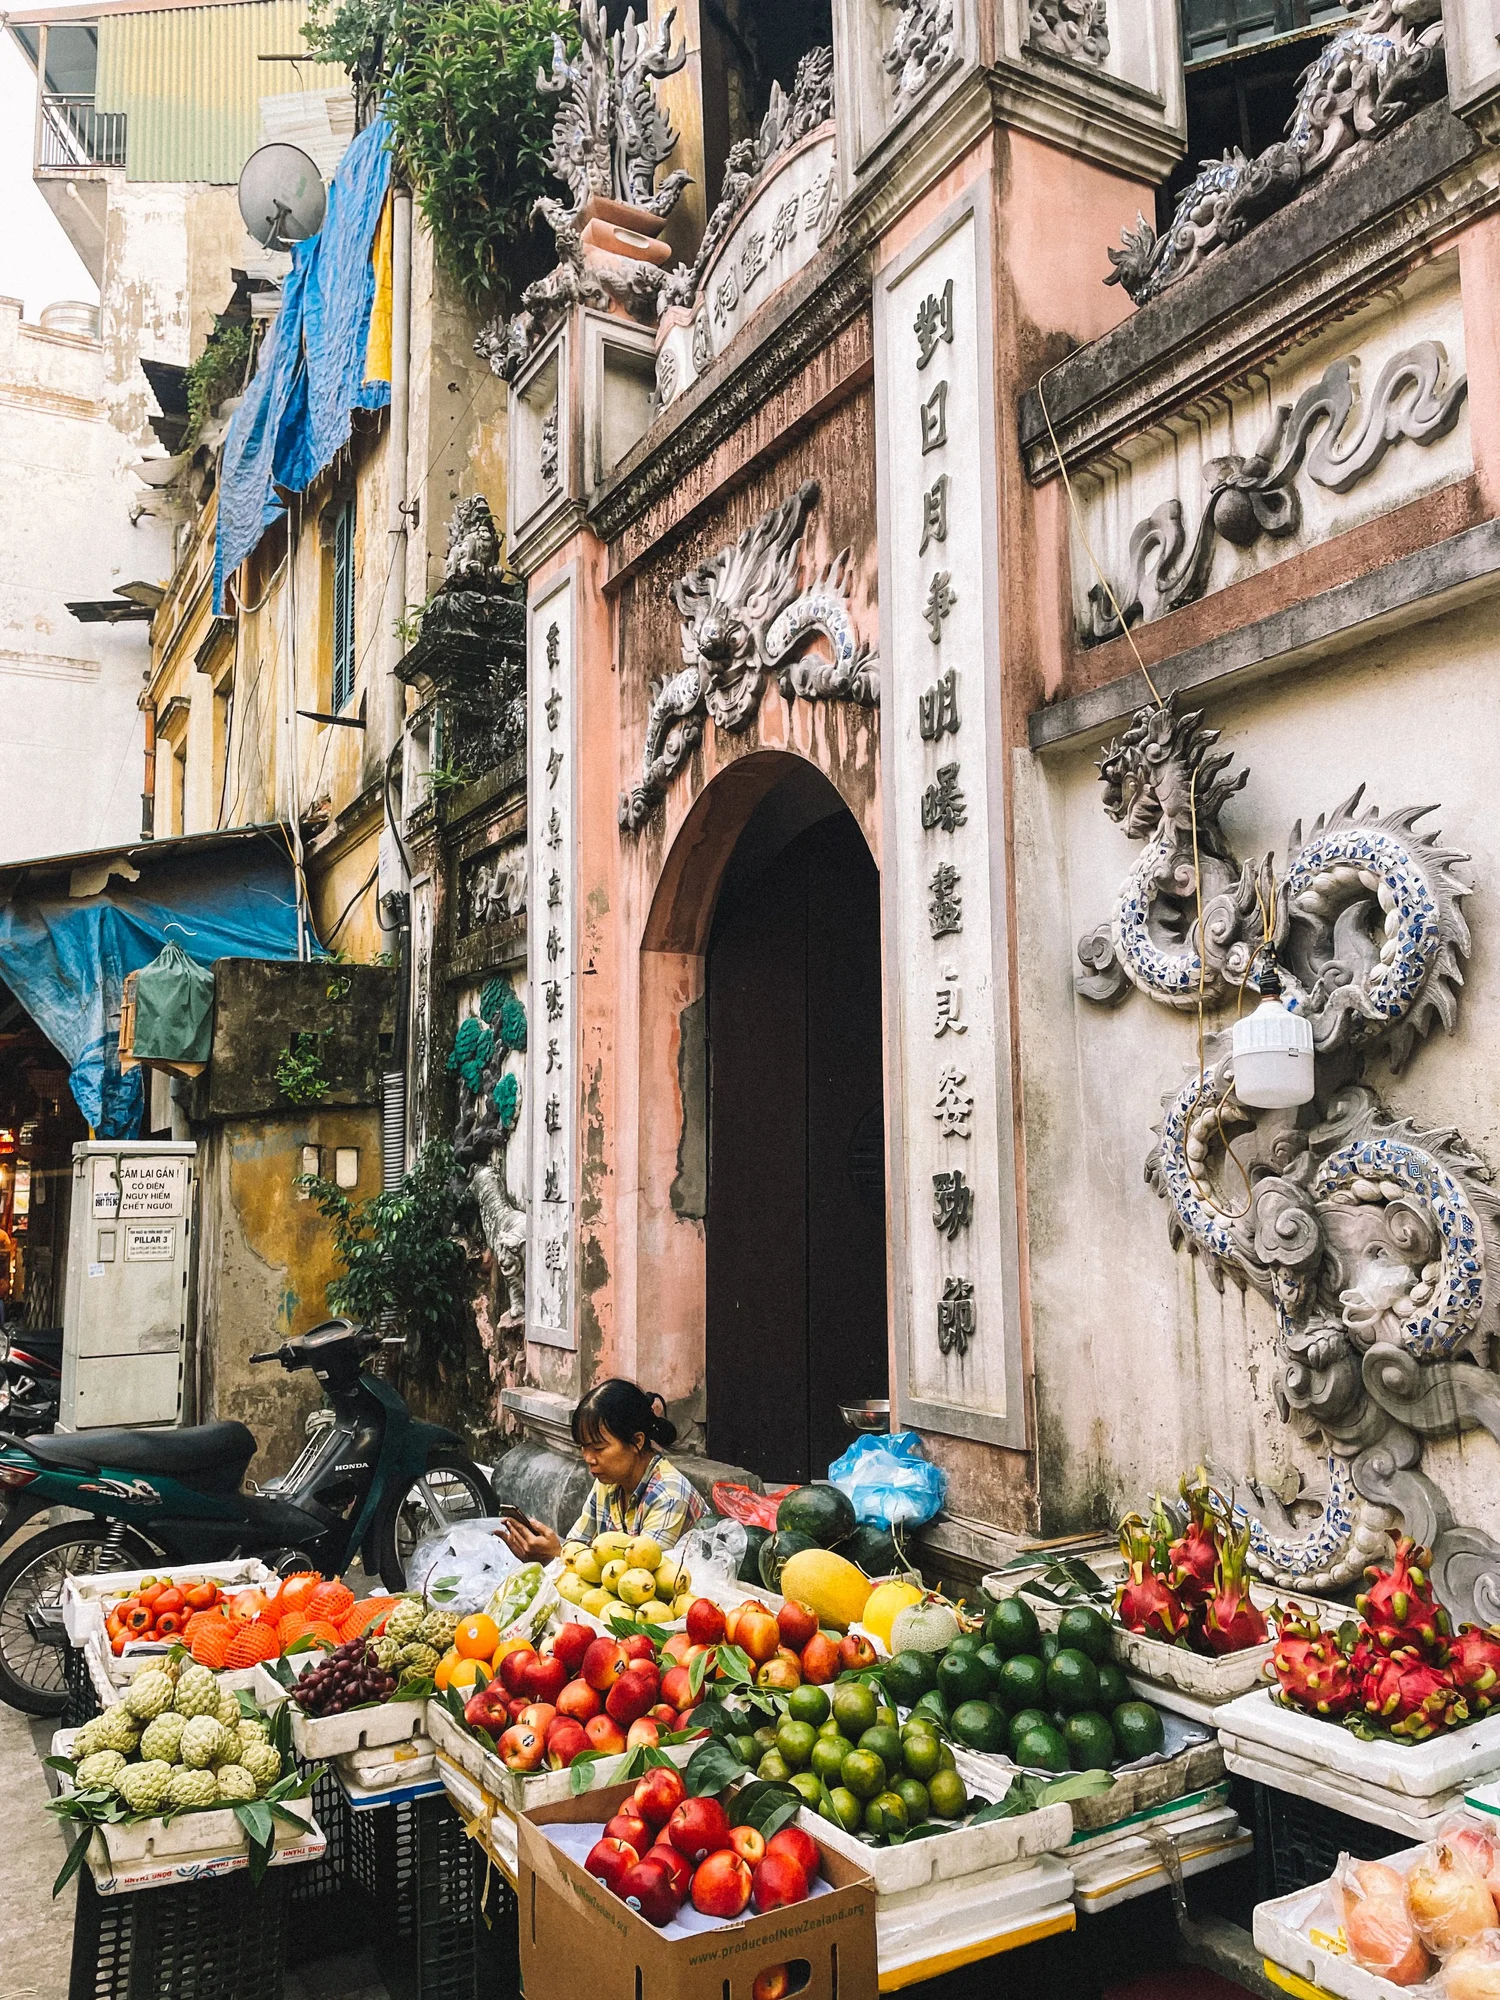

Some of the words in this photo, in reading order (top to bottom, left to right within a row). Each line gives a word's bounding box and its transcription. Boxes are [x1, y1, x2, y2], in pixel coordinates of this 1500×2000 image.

[134, 1236, 161, 1244] PILLAR
[163, 1236, 168, 1244] 3
[334, 1462, 369, 1471] HONDA
[689, 1904, 864, 1966] www.produceofNewZealand.org
